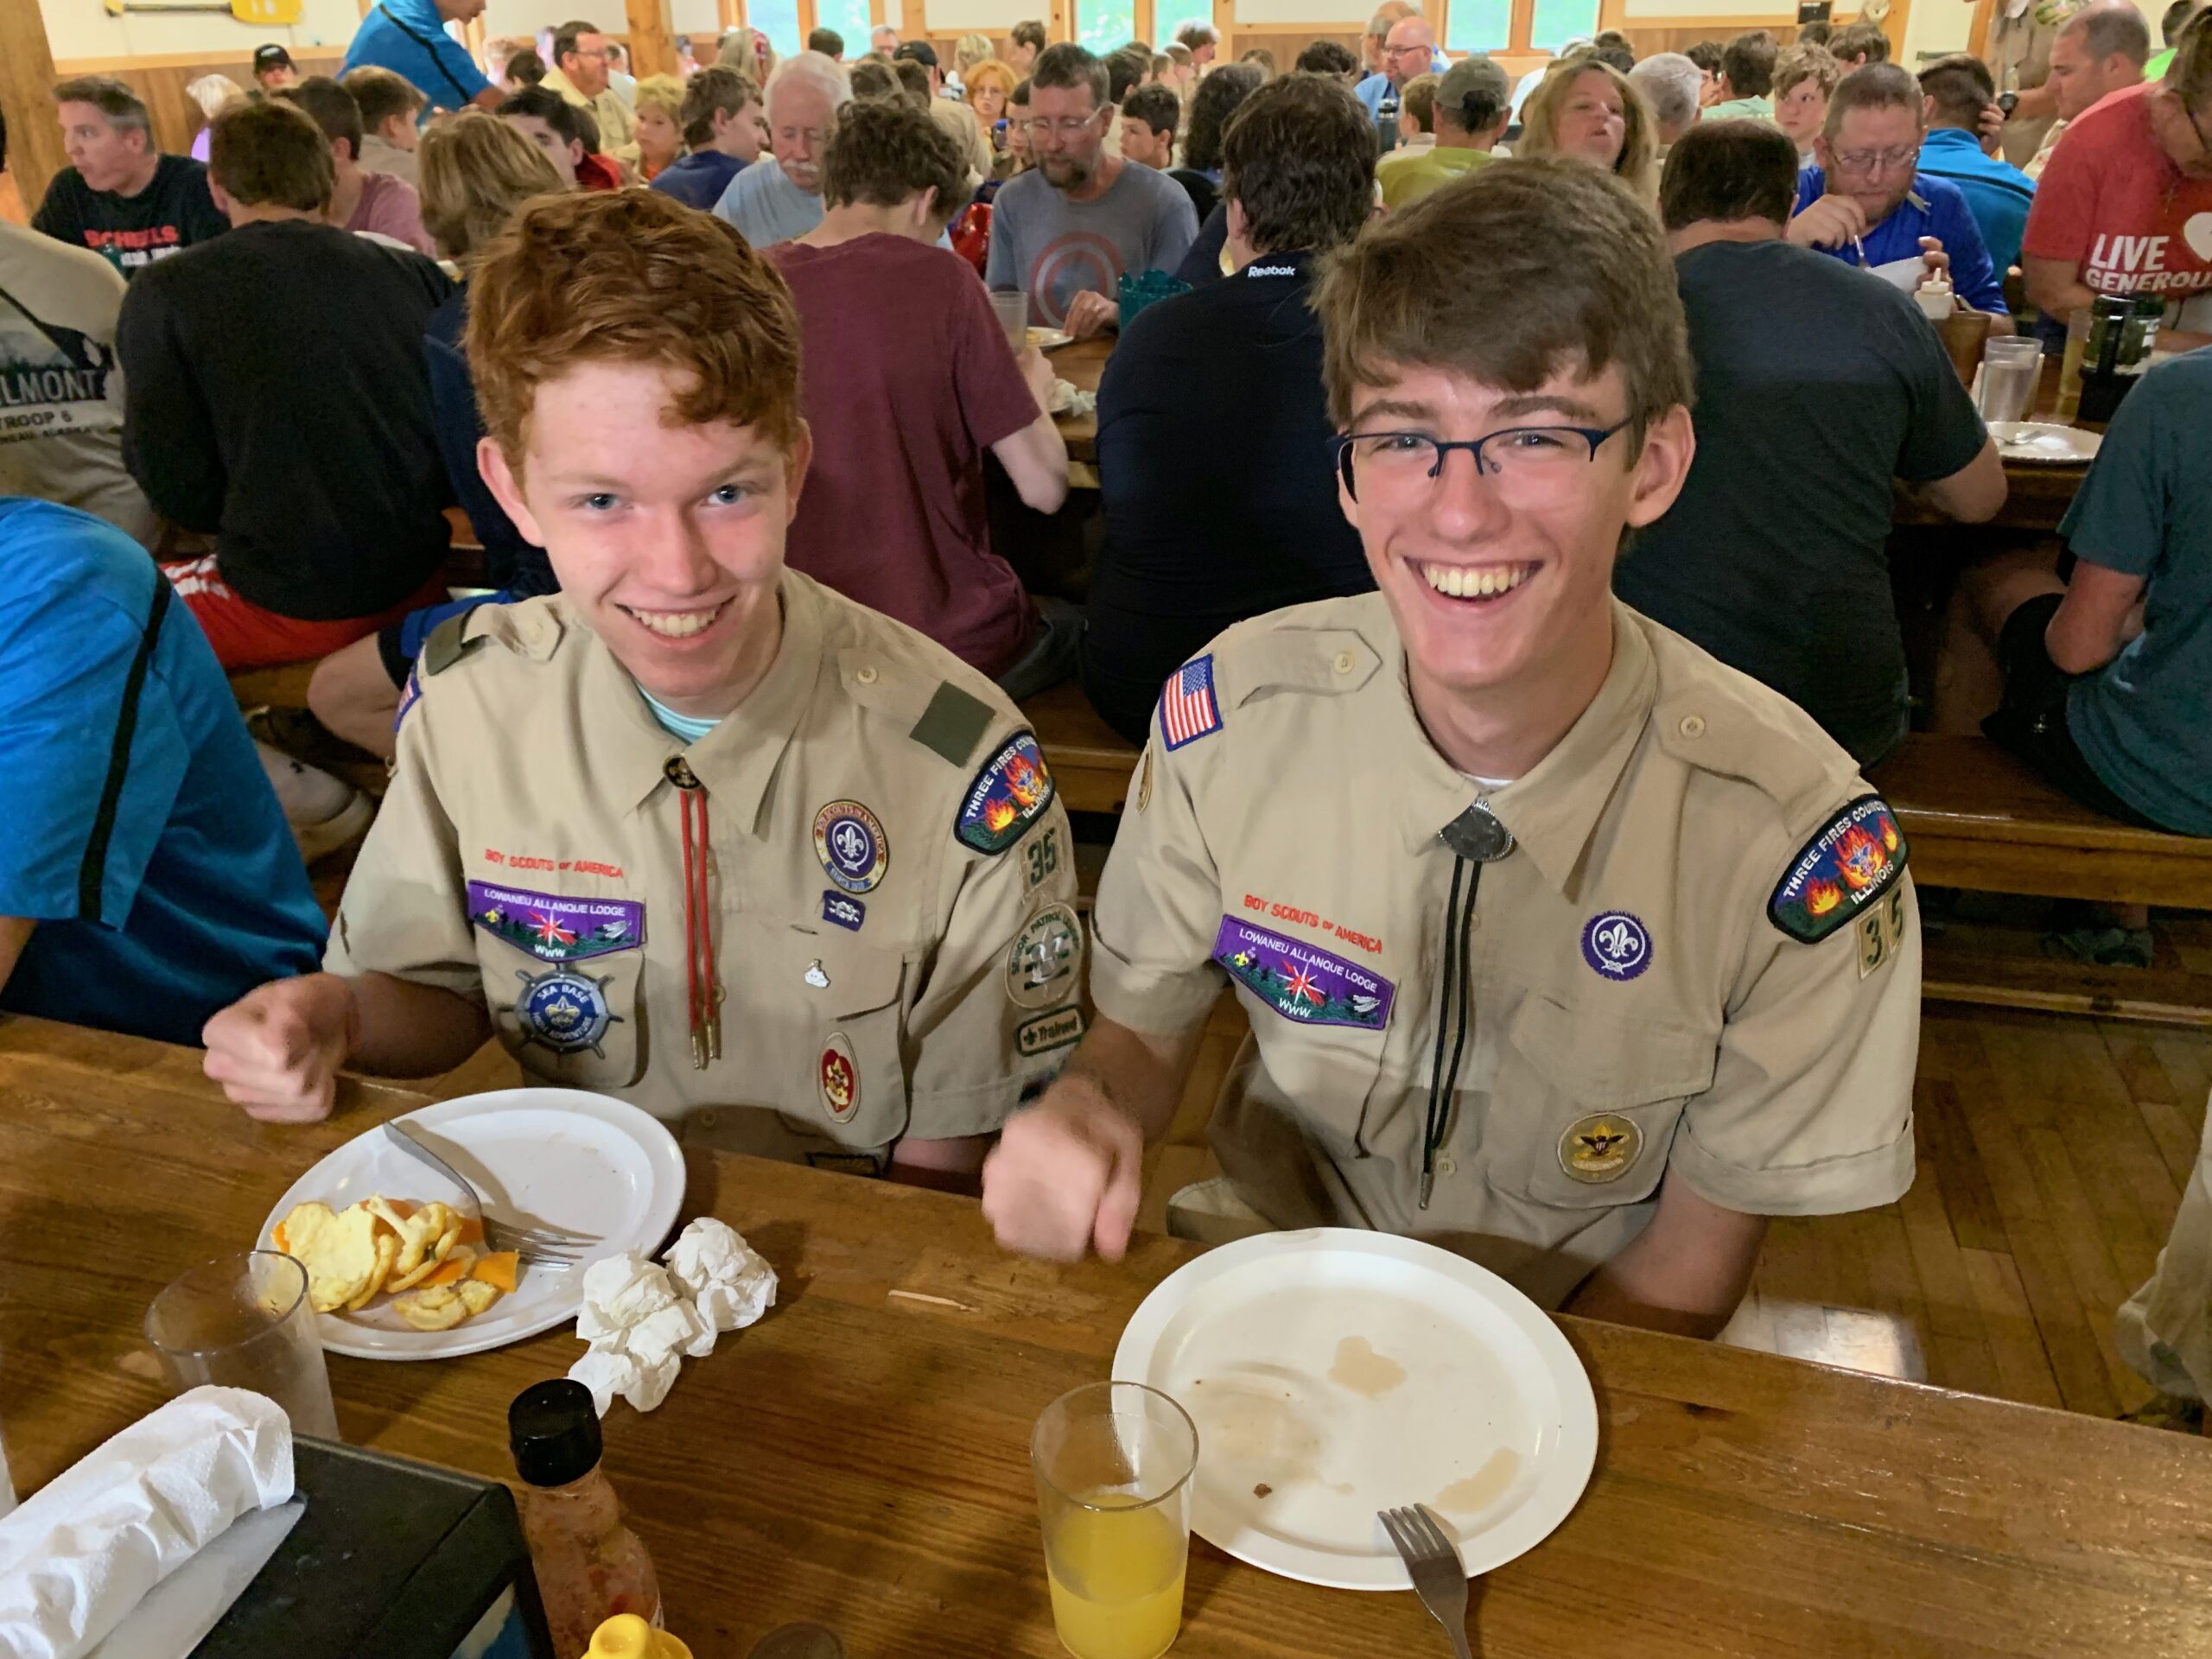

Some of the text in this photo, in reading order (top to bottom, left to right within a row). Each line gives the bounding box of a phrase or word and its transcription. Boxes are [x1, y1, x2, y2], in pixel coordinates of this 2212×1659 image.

[2089, 233, 2170, 271] LIVE
[1248, 265, 1296, 277] Reebok
[2085, 268, 2212, 292] GENEROU
[0, 369, 97, 404] LMONT
[965, 774, 995, 818] THREE
[989, 746, 1017, 776] FIRES
[485, 849, 505, 864] BOY
[509, 856, 554, 872] SCOUTS
[574, 860, 624, 879] AMERICA
[1028, 827, 1056, 885] 35
[1783, 849, 1821, 898] THREE
[1818, 817, 1852, 852] FIRES
[1850, 859, 1894, 905] ILLINOIS
[484, 888, 625, 917] LOWANEU ALLANQUE LODGE
[1243, 894, 1268, 912] BOY
[1271, 904, 1319, 928] SCOUTS
[1335, 925, 1382, 955] AMERICA
[534, 944, 566, 958] WWW
[1239, 928, 1377, 994] LOWANEU ALLANQUE LODGE
[537, 984, 589, 1003] SEA BASE
[1279, 997, 1312, 1018] WWW
